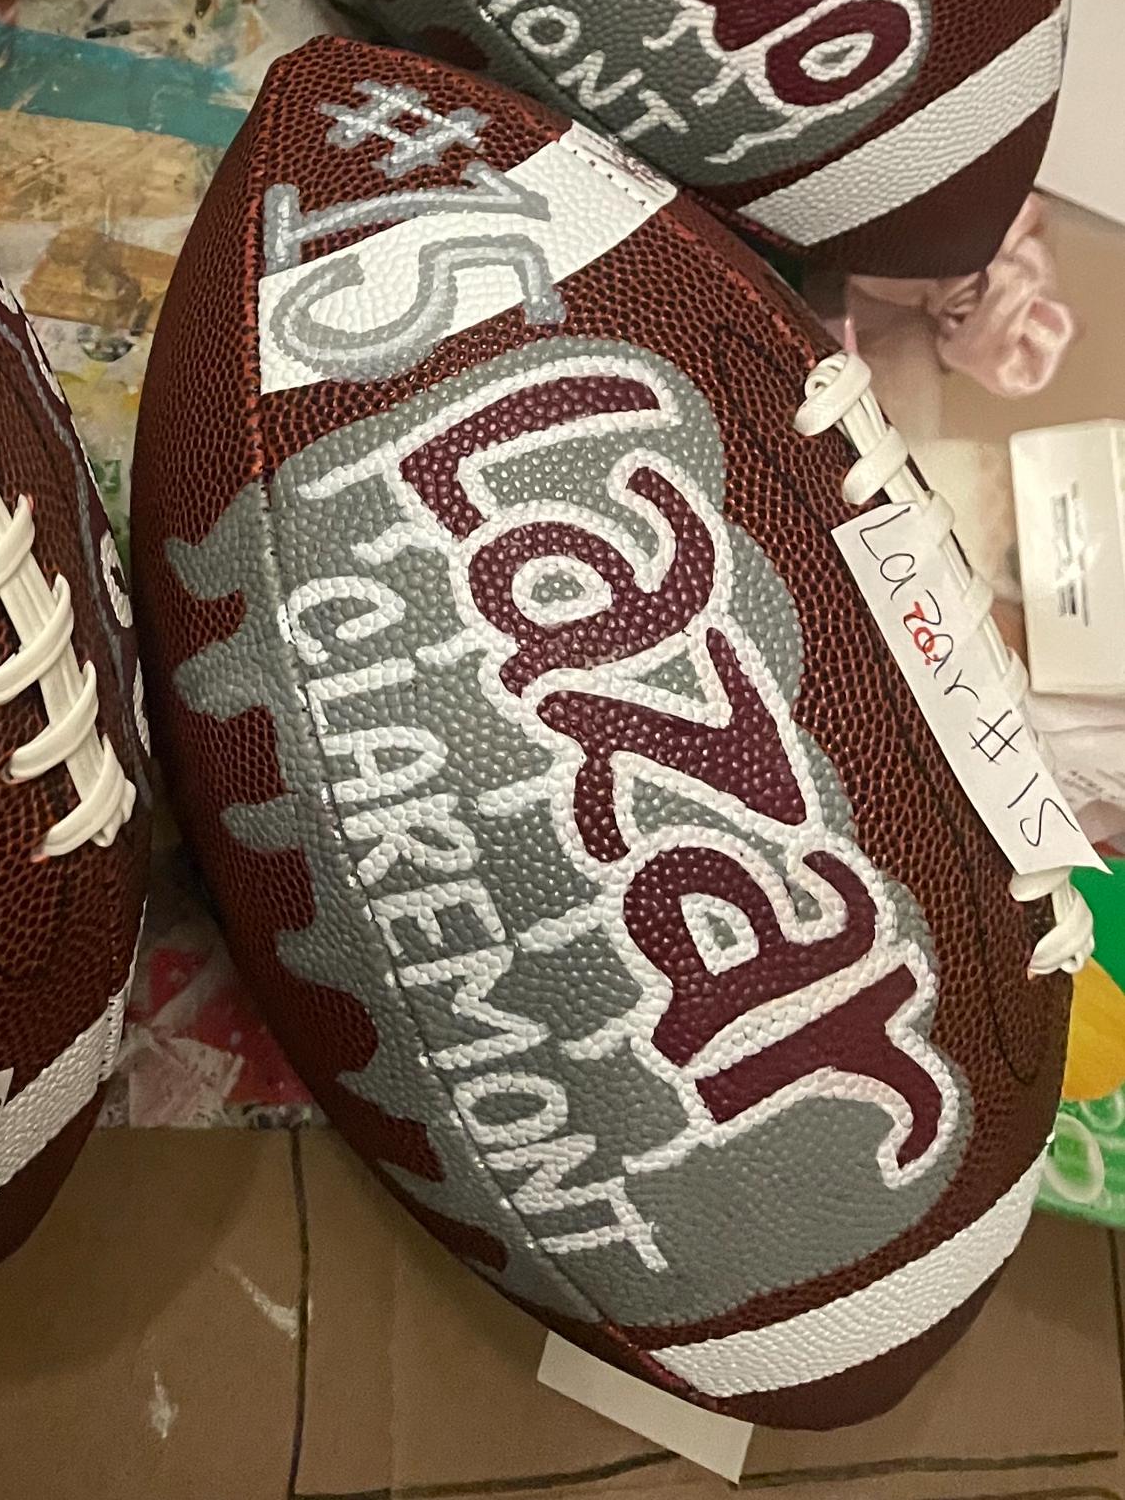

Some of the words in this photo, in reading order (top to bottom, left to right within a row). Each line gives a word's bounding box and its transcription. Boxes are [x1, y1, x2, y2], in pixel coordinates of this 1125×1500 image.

[263, 80, 567, 382] #15
[276, 574, 669, 1275] CLAREMONT
[393, 355, 962, 1190] Lazer
